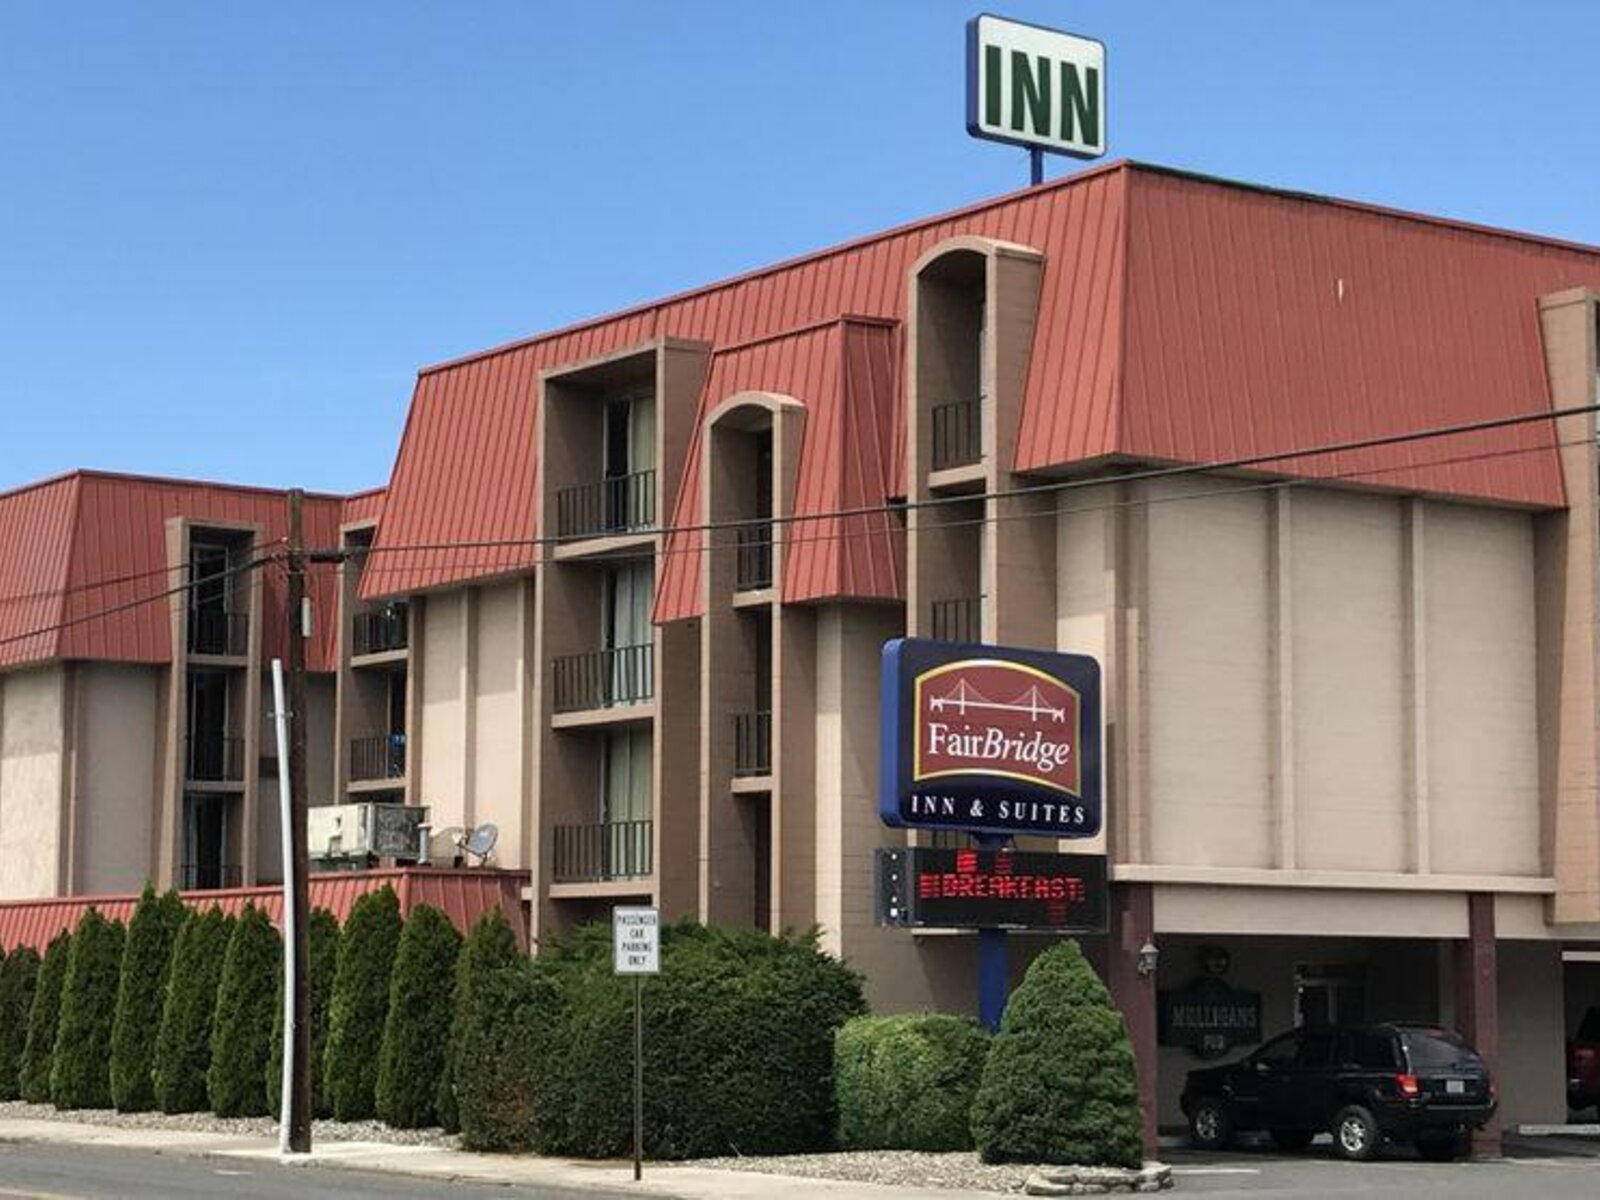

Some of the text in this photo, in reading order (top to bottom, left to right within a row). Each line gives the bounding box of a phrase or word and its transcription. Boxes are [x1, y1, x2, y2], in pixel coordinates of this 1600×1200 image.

[985, 44, 1099, 147] INN
[928, 722, 1070, 771] FairBridge
[911, 795, 1085, 824] INN & SUITES
[621, 942, 653, 953] PARKING
[628, 954, 646, 967] ONLY
